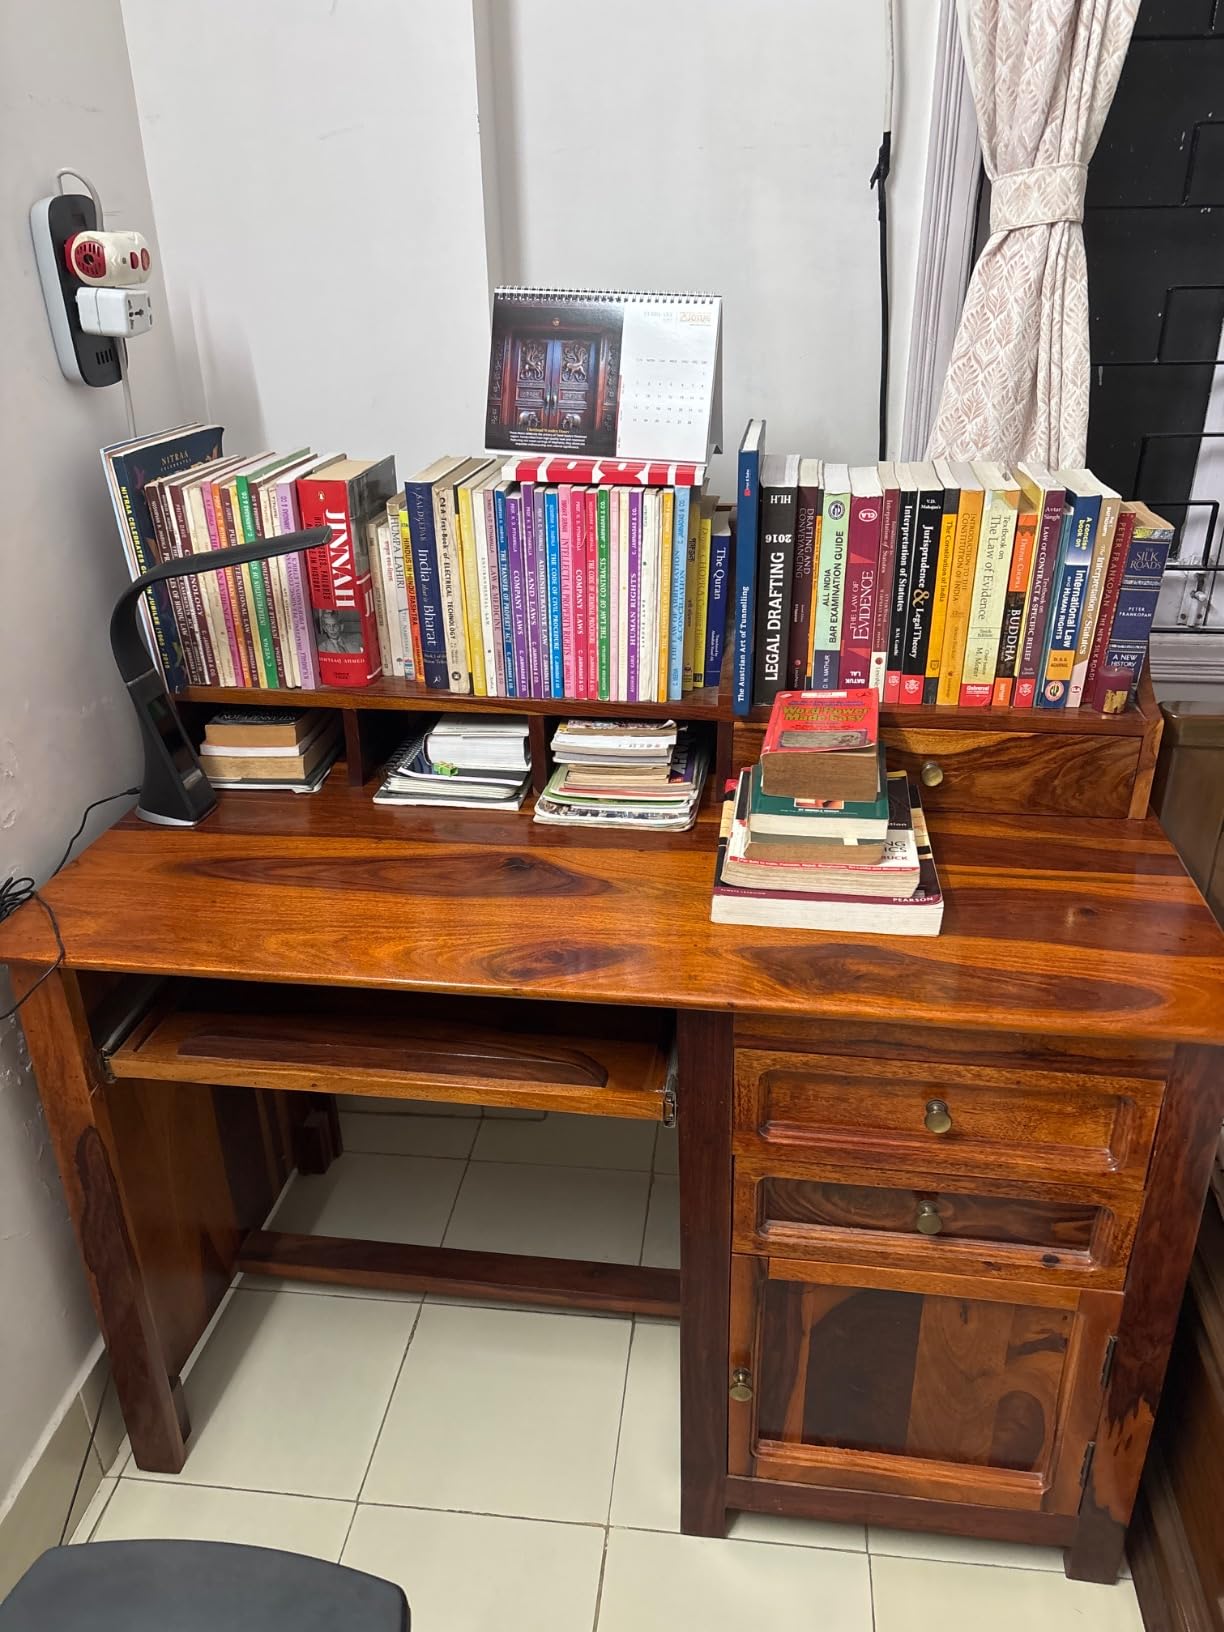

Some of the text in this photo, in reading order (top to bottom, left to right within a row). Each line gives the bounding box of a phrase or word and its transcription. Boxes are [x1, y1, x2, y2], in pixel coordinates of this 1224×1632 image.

[161, 451, 188, 465] NITRAA
[770, 494, 791, 504] HLH
[390, 513, 406, 589] JHUMPA LAHIRI
[403, 537, 411, 564] HINDUS
[765, 533, 792, 543] 2016
[796, 508, 806, 578] CONVEYANCING
[804, 508, 814, 574] DRAFTING AND
[956, 513, 970, 568] CONSTITUTION
[965, 513, 976, 565] INTRODUCTION
[998, 516, 1010, 560] Textbook on
[1040, 542, 1048, 551] OF
[1042, 526, 1051, 542] LAW
[1075, 519, 1085, 548] book on
[1081, 523, 1091, 551] concise
[1115, 522, 1126, 548] PETER
[121, 486, 160, 625] NITRAA CELEBRATES JUBILEE
[325, 506, 356, 610] JINNAH
[443, 552, 450, 560] of
[714, 547, 726, 600] The Quran
[896, 505, 913, 612] Interpretation of Statutes
[941, 535, 951, 577] Constitution
[963, 568, 970, 577] TO
[978, 514, 1001, 621] The Law of Evidence
[1034, 551, 1047, 595] CONTRACT
[1130, 559, 1161, 571] ROADS
[1135, 551, 1159, 562] SILK
[407, 574, 415, 594] HINDU
[418, 549, 438, 647] India Bharat
[444, 561, 453, 597] ELECTRICAL
[499, 550, 513, 643] THE TRANSFER OF PROPERTY ACT
[514, 570, 522, 610] COMPANY
[539, 559, 547, 627] ADMINISTRATIVE
[552, 584, 558, 594] OF
[561, 538, 571, 656] INTELLECTUAL PROPERTY RIGHTS
[672, 550, 680, 608] ARBITRATION
[822, 569, 831, 606] ALL INDIA
[829, 531, 844, 643] BAR EXAMINATION GUIDE
[852, 582, 858, 592] OF
[909, 524, 933, 659] Jurisprudence & Legal Theory
[952, 581, 961, 602] INDIA
[1038, 577, 1050, 614] Textbook on
[1103, 552, 1120, 607] FRANKOPAN
[172, 590, 189, 637] OF HINDU LAW
[254, 581, 267, 626] INTERPRETATION
[409, 595, 418, 625] RASHTRA
[447, 601, 457, 639] TECHNOLOGY
[492, 593, 501, 631] MEDICINE
[600, 600, 606, 608] OF
[672, 612, 678, 622] OF
[677, 570, 685, 633] CONCILIATION
[740, 586, 748, 629] Tunnelling
[764, 552, 784, 681] LEGAL DRAFTING
[854, 570, 874, 640] EVIDENCE
[1027, 603, 1039, 637] SPECIFIC
[1054, 587, 1071, 640] HUMAN RIGHTS
[1063, 569, 1085, 648] International Law
[1078, 557, 1105, 656] Interpretation Statutes
[740, 630, 747, 638] of
[976, 647, 983, 655] M.
[1004, 608, 1021, 662] BUDDHA
[1023, 637, 1034, 662] RELIEF
[1087, 613, 1107, 681] THE NEW SILK ROADS
[738, 654, 746, 687] Austrian
[784, 706, 869, 714] Word Power
[785, 713, 825, 721] Made
